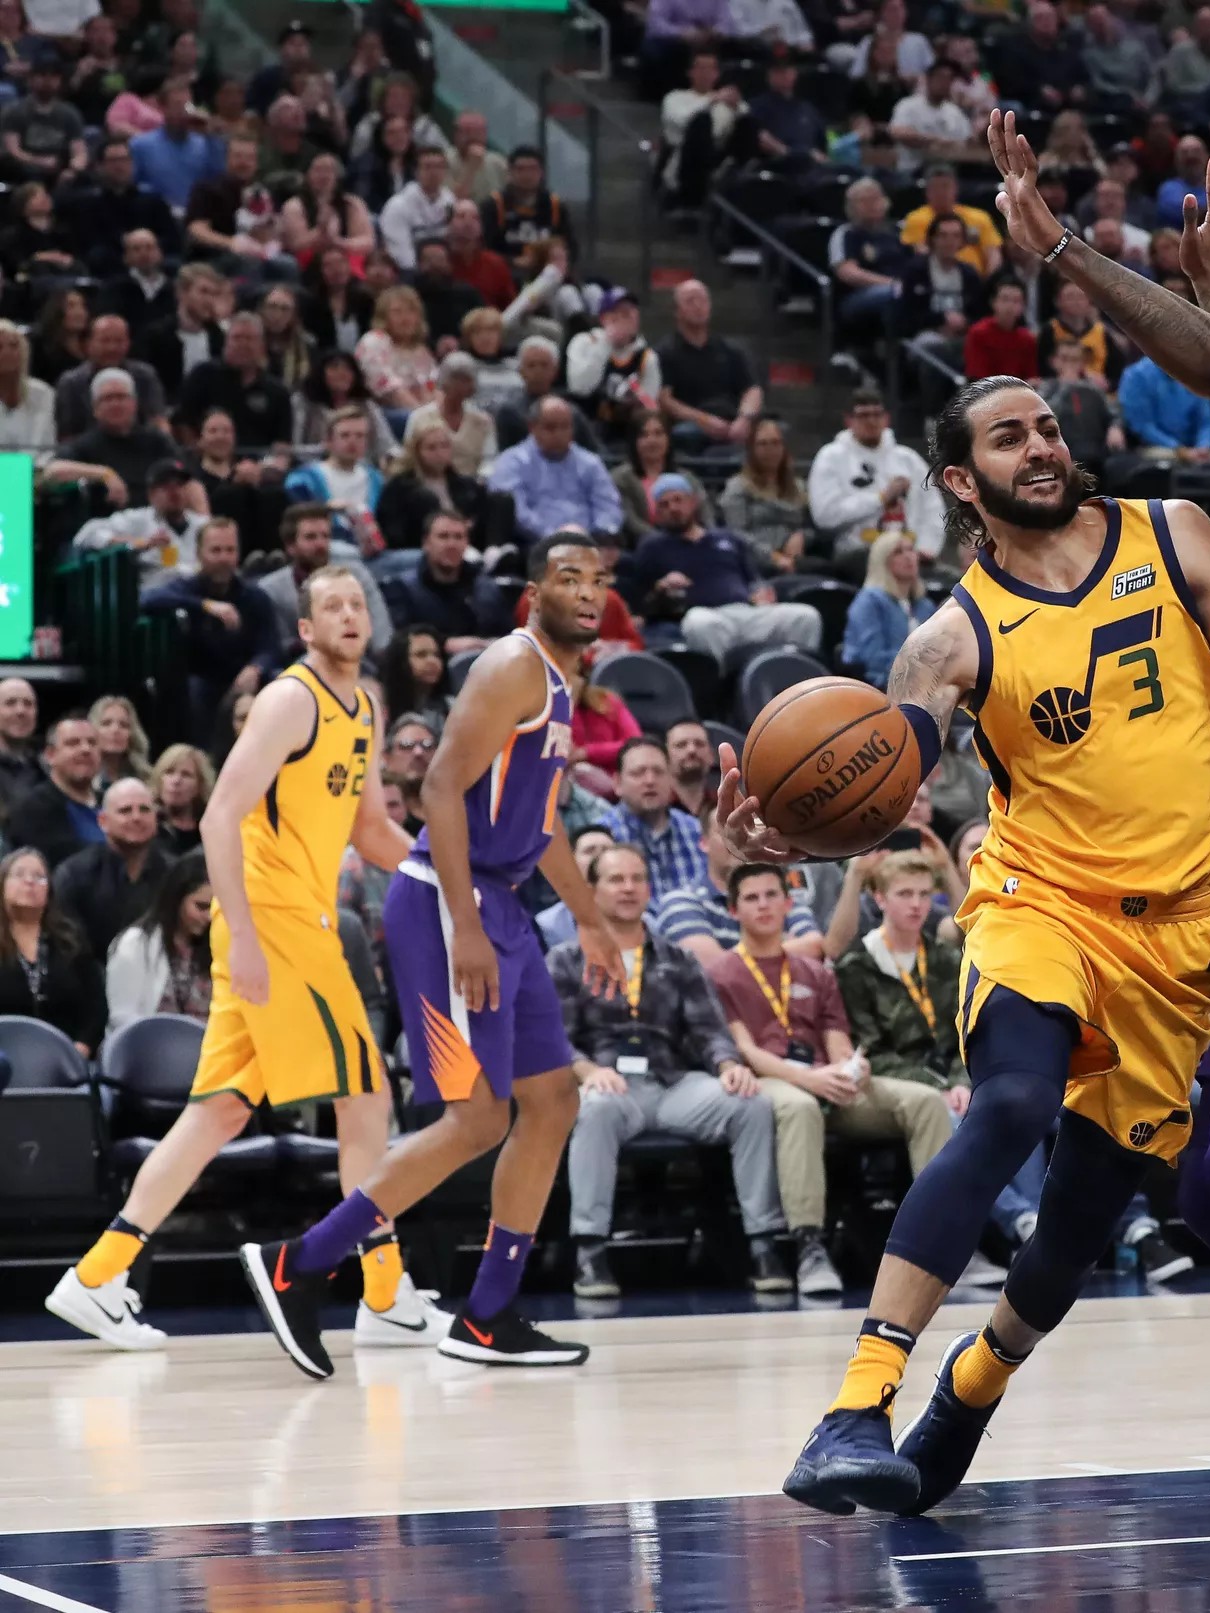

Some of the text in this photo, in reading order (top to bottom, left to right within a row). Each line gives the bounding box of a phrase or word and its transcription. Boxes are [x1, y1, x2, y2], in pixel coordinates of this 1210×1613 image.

[1127, 574, 1153, 592] FIGHT
[1129, 570, 1139, 579] FOR
[1115, 575, 1125, 596] 5
[1118, 647, 1165, 721] 3
[786, 730, 895, 825] SPALDING
